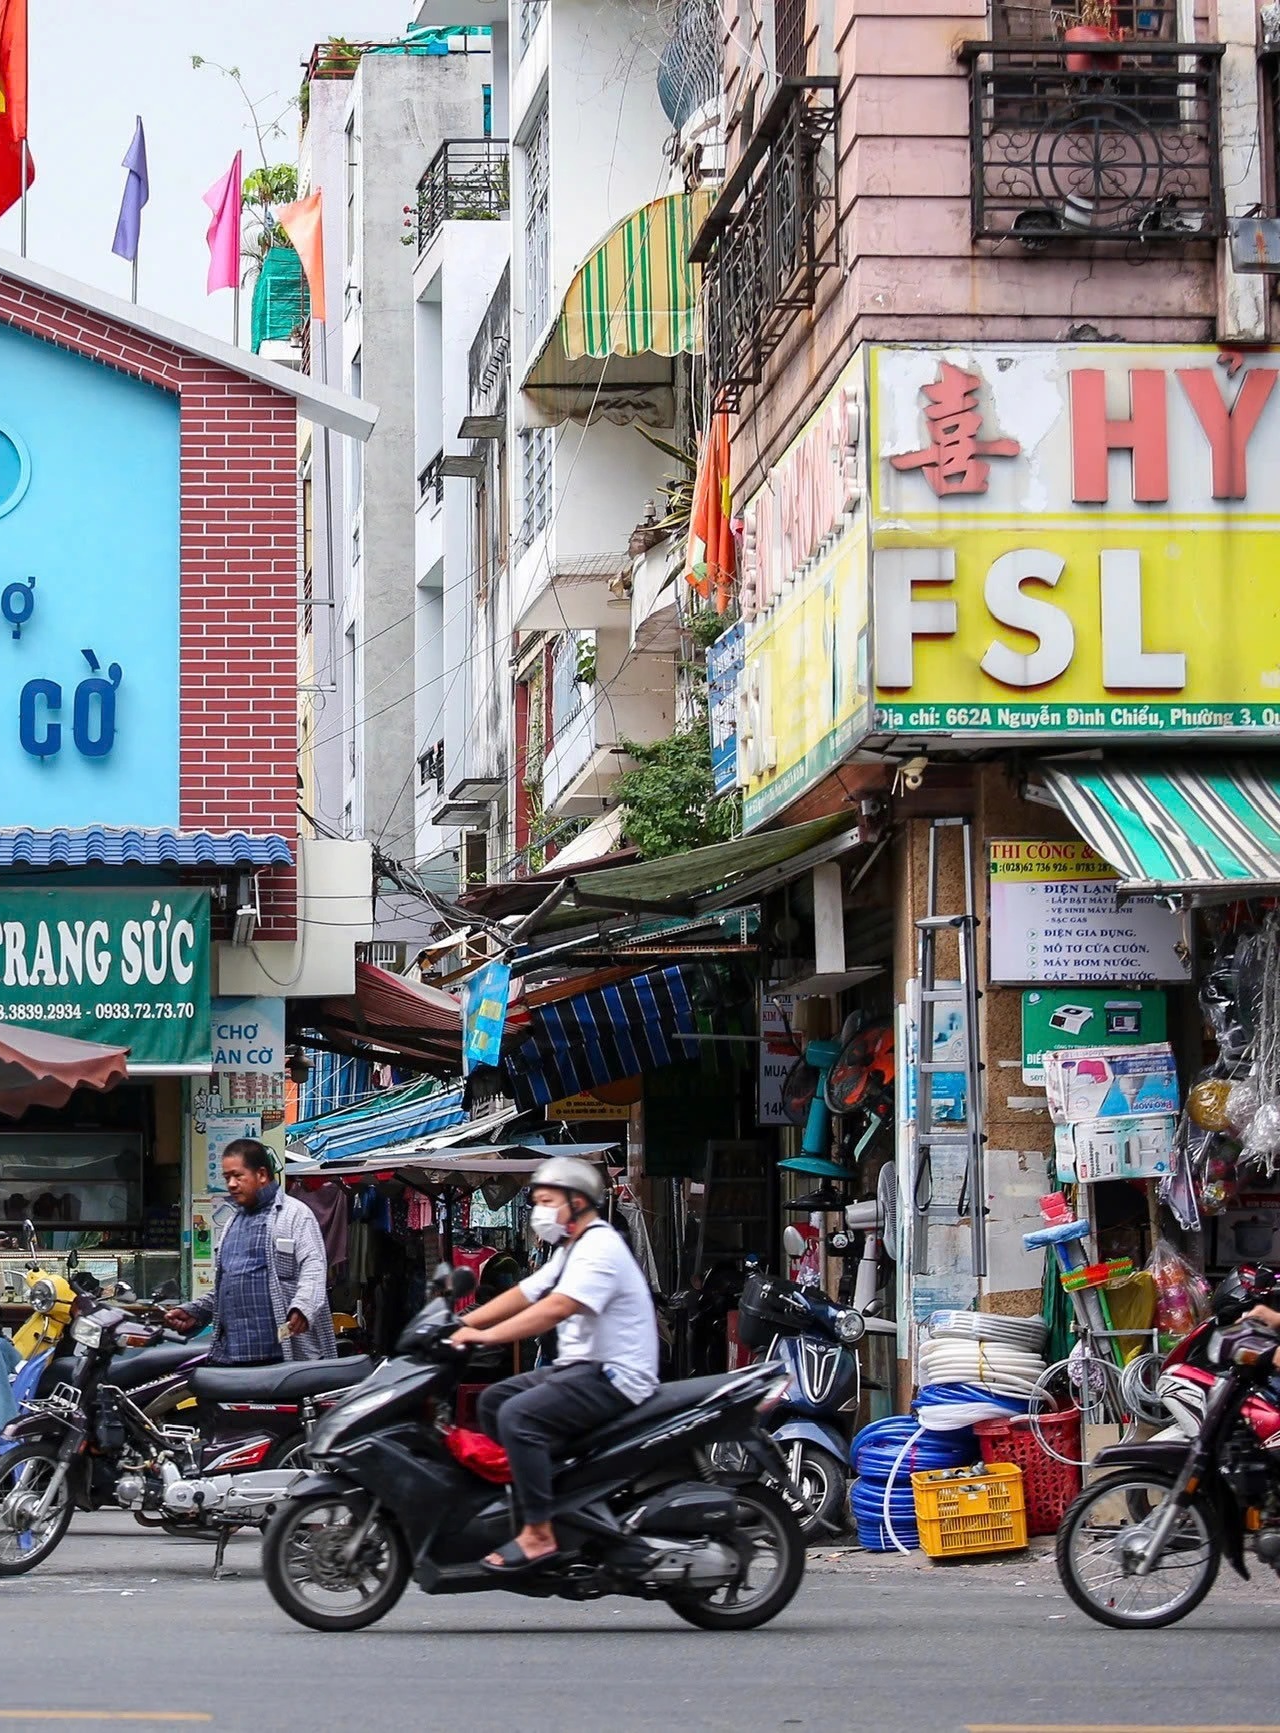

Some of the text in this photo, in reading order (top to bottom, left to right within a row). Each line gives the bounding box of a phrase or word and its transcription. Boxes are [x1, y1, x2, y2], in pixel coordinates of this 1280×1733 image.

[889, 360, 1021, 498] 喜
[873, 547, 1187, 689] FSL
[19, 649, 123, 757] CỜ
[909, 707, 941, 725] chỉ:
[946, 708, 992, 725] 662A
[998, 704, 1061, 728] Nguyễn
[1066, 708, 1106, 726] Đình
[1111, 705, 1165, 728] Chiểu,
[1171, 708, 1234, 726] Phường
[991, 844, 1020, 859] THI
[1026, 841, 1075, 860] CÔNG
[1035, 862, 1050, 873] 736
[1053, 862, 1068, 873] 926
[1044, 884, 1079, 895] ĐIỆN
[1088, 906, 1107, 914] MÁY
[121, 900, 196, 986] SỨC
[1044, 929, 1136, 939] ĐIỆN GIA DỤNG.
[1065, 944, 1082, 953] TƠ
[1043, 957, 1141, 967] MÁY BƠM NƯỚC.
[95, 1002, 195, 1019] 0933.72.73.70
[216, 1023, 259, 1044] CHỢ
[247, 1046, 273, 1065] CỜ
[764, 1065, 788, 1077] MUA
